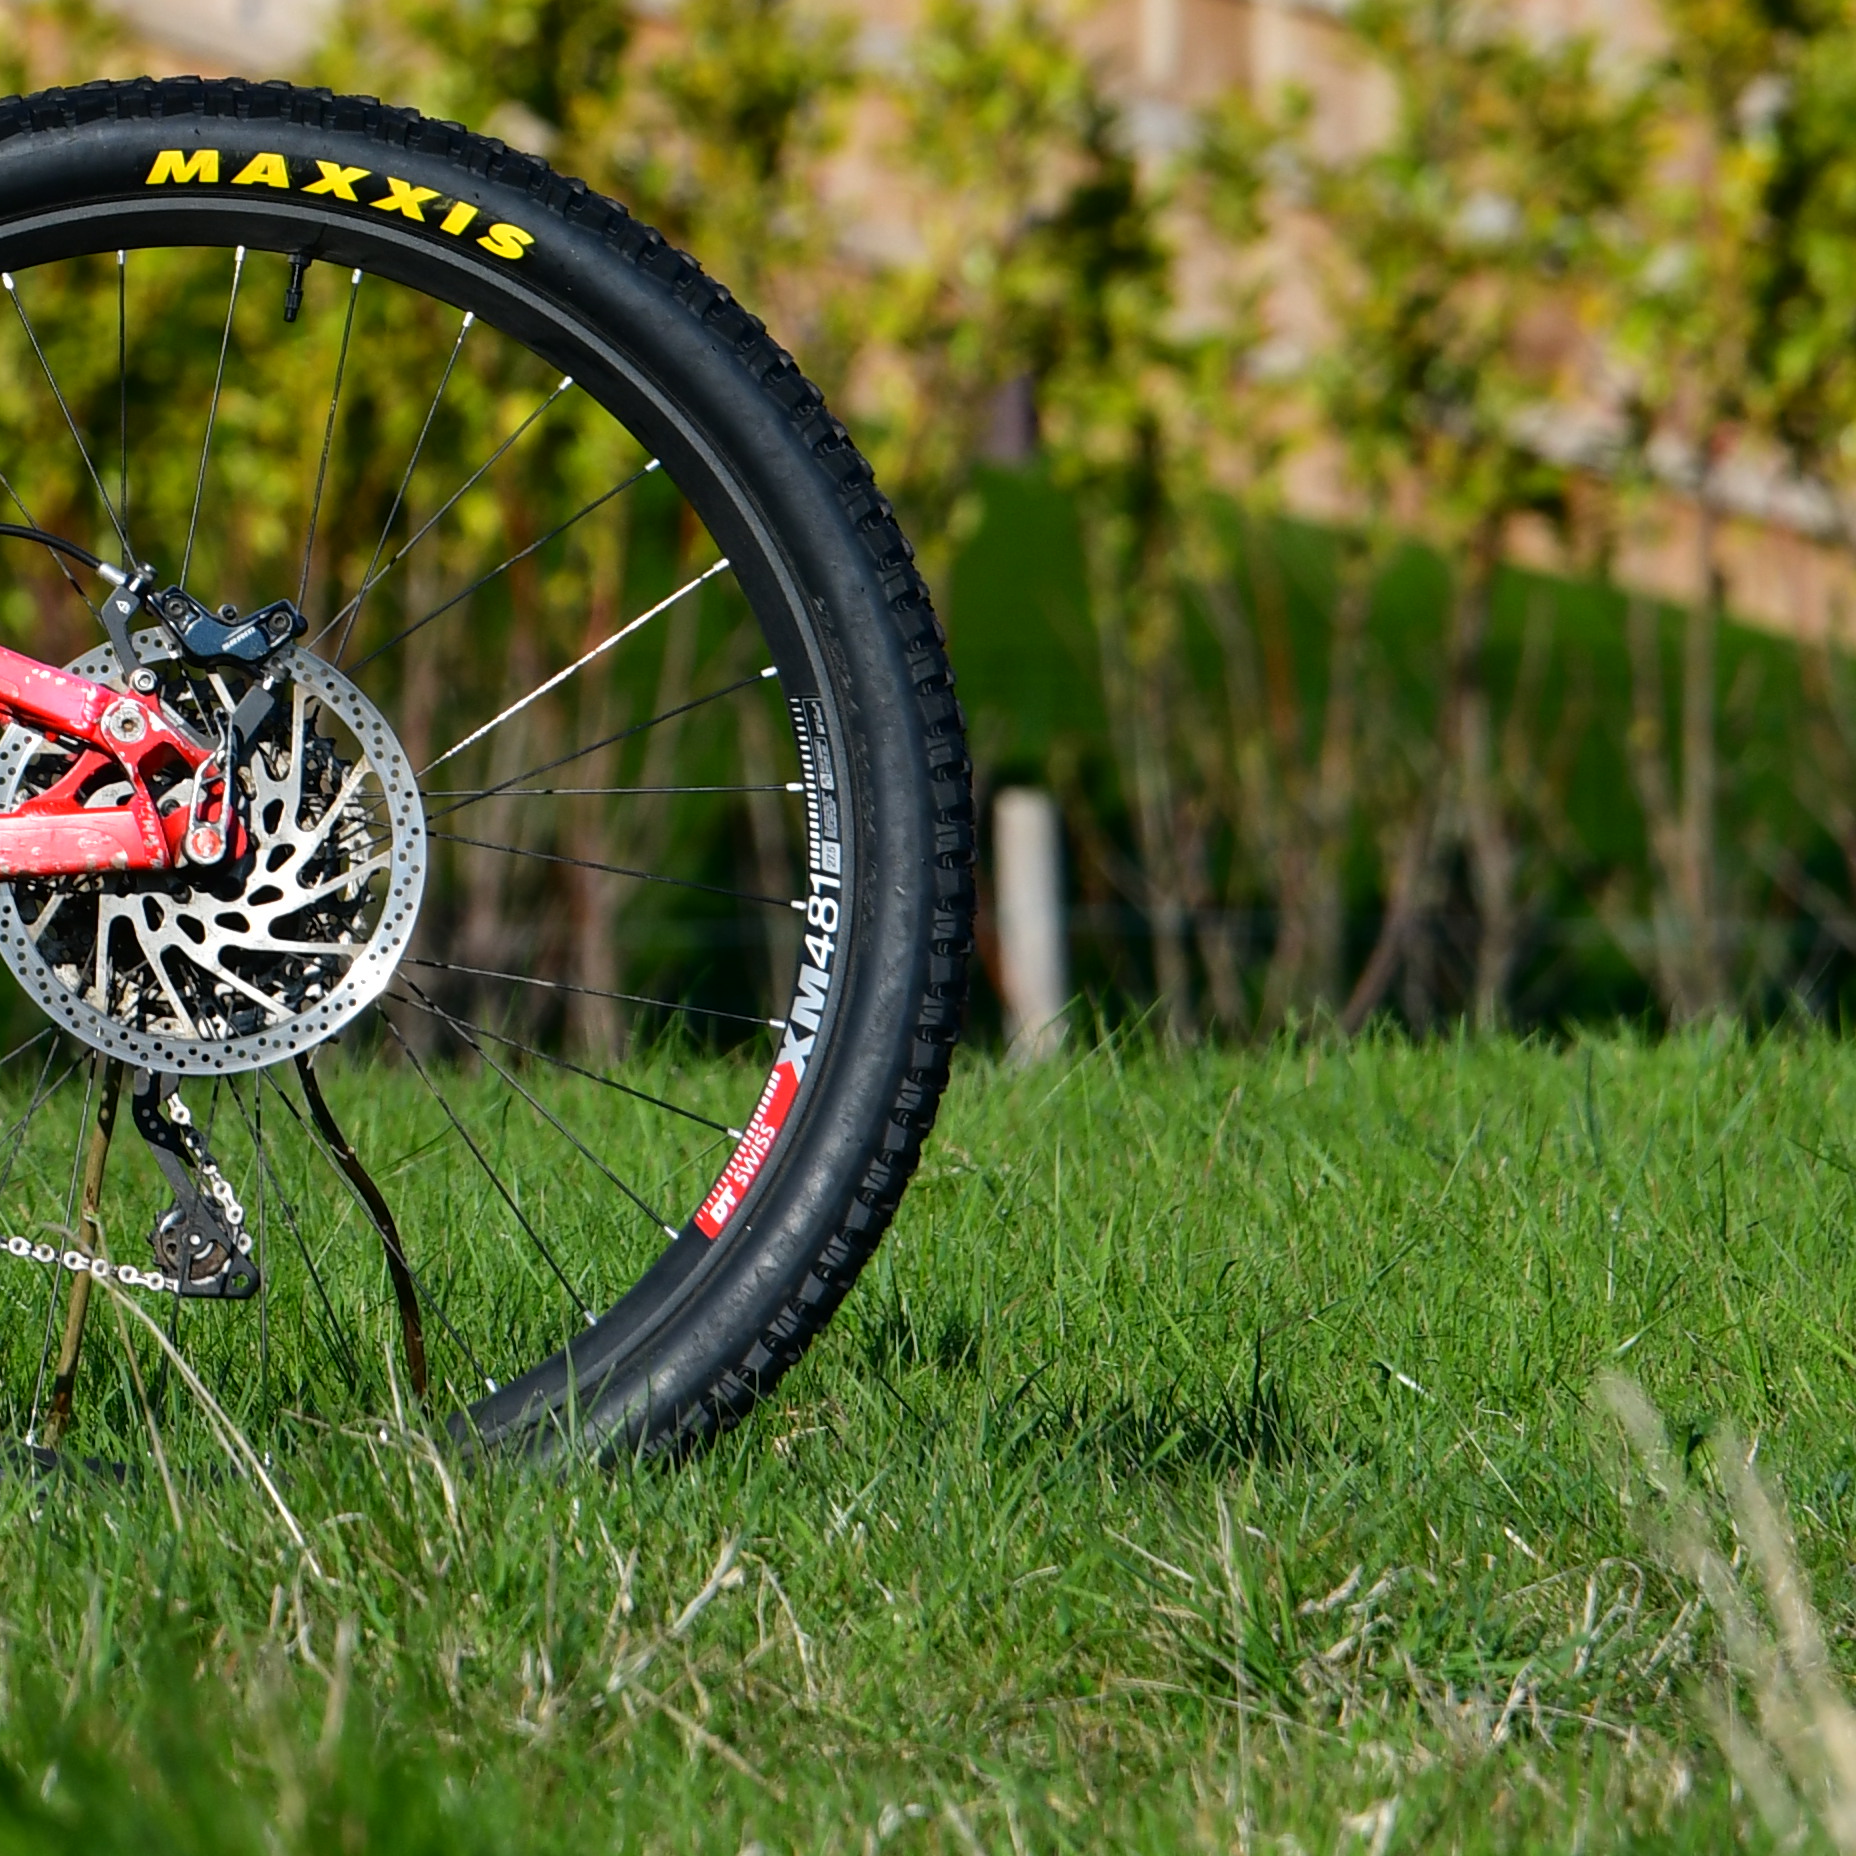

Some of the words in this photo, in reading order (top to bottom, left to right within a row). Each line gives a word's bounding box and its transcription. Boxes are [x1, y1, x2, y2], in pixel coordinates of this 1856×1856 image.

[145, 149, 535, 260] MAXXIS
[775, 872, 841, 1083] XM481
[710, 1186, 737, 1224] DT
[734, 1125, 776, 1186] SWISS
